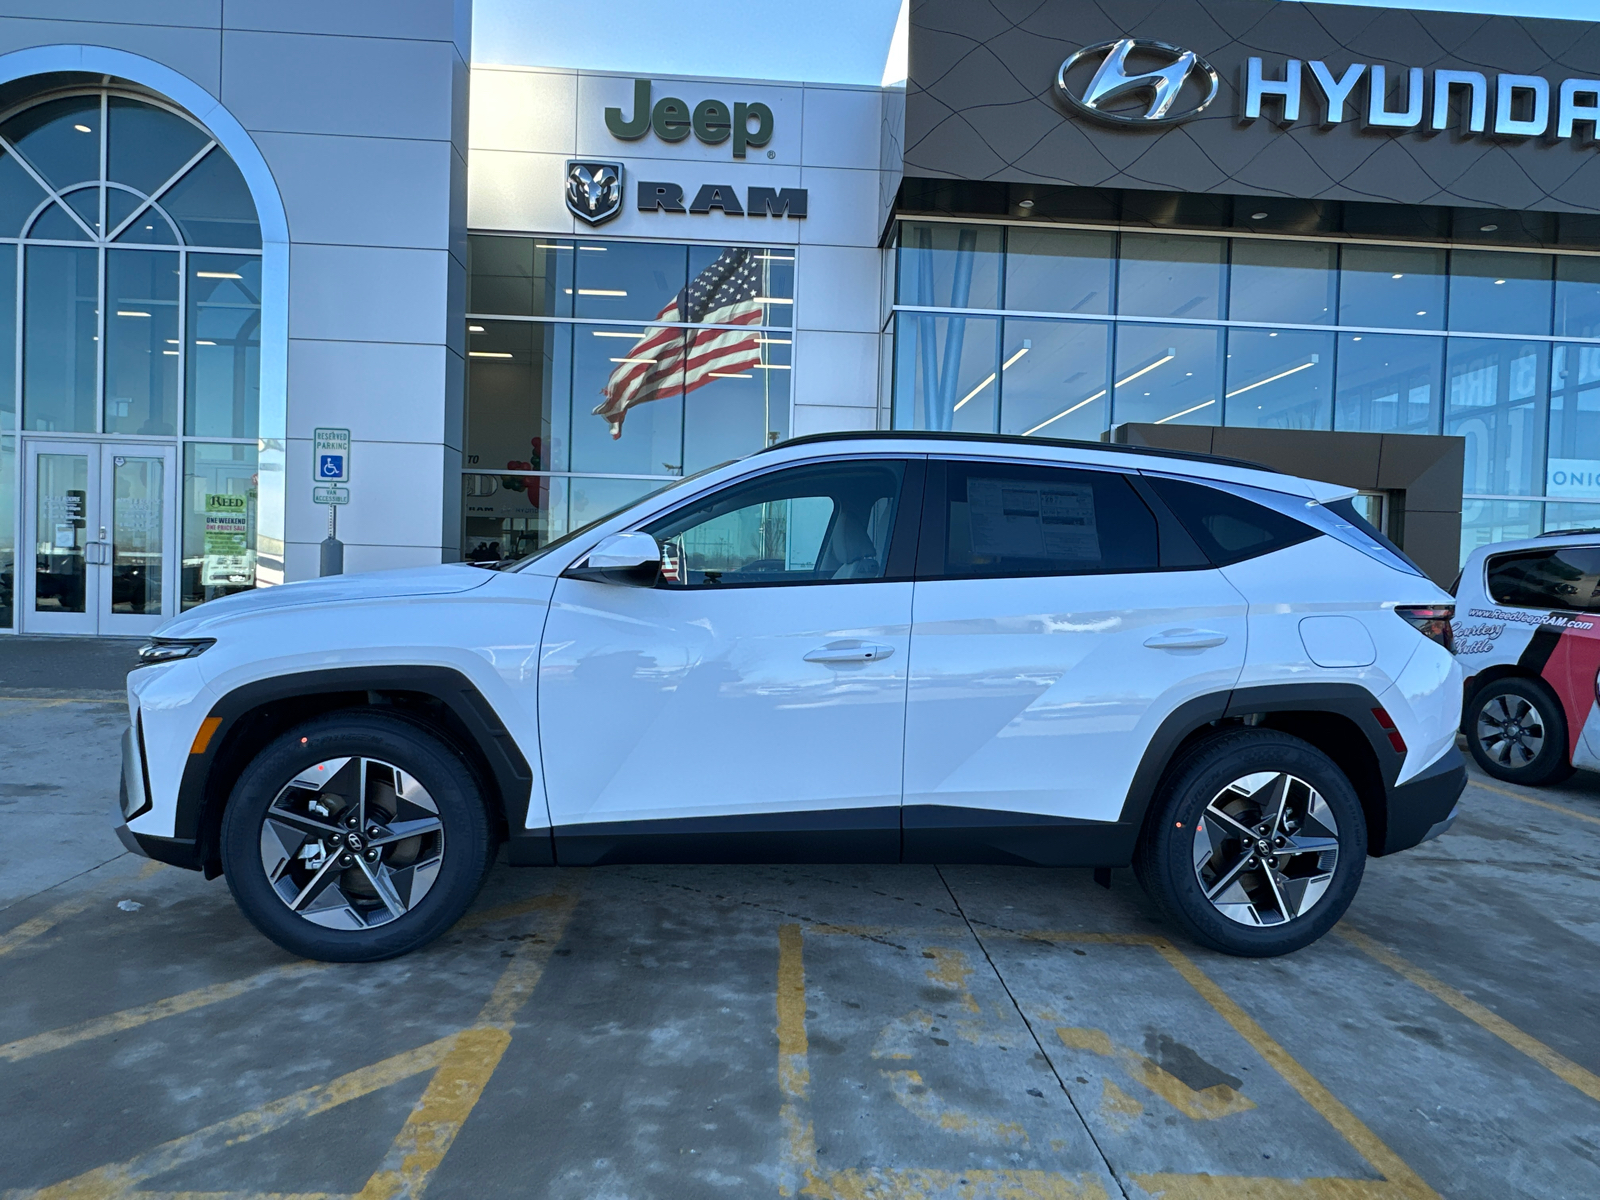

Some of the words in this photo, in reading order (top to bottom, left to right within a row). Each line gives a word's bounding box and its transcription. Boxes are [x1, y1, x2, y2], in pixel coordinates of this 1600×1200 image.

[1242, 56, 1600, 141] HYUNDA
[604, 79, 774, 158] Jeep
[636, 181, 808, 219] RAM
[317, 431, 347, 440] RESERVED
[317, 441, 347, 450] PARKING
[209, 495, 244, 509] REED
[218, 517, 246, 525] WEEKEND
[1468, 608, 1594, 630] www.ReedJeepRAM.com
